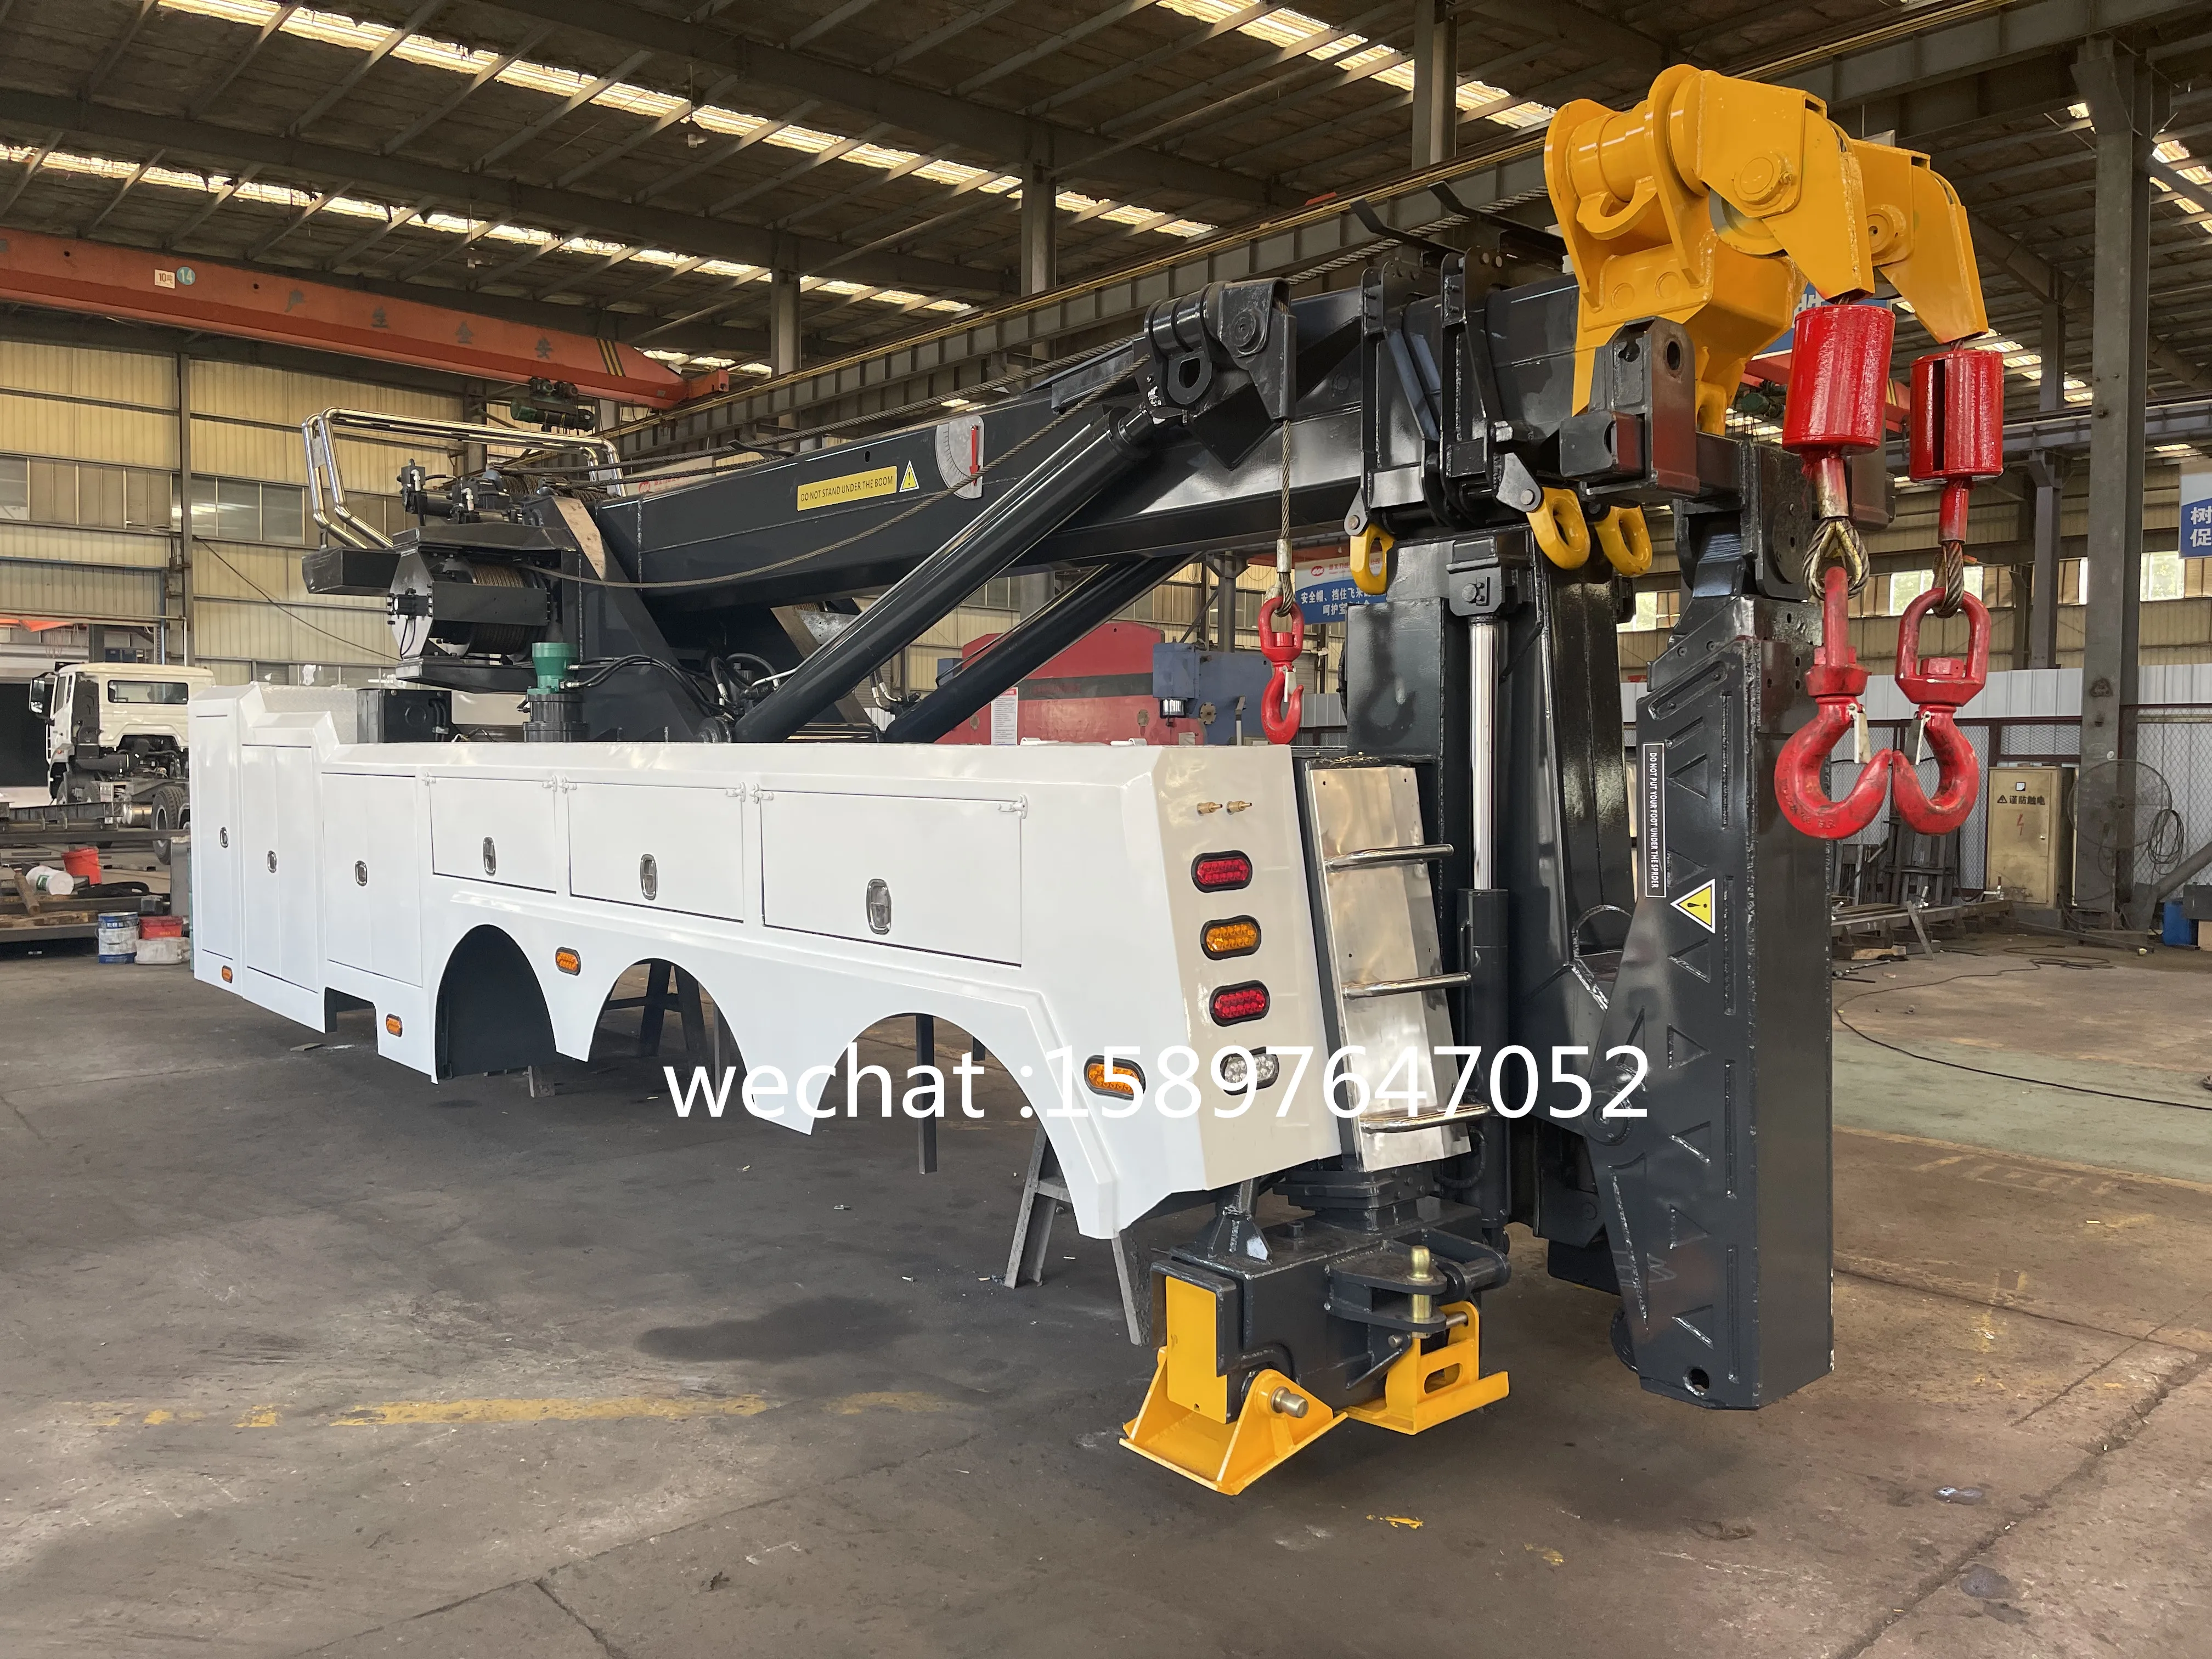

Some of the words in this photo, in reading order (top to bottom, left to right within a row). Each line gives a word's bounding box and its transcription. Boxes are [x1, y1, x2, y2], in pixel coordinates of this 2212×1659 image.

[179, 269, 193, 283] 14
[801, 492, 809, 501] DO
[810, 489, 821, 499] NOT
[822, 486, 840, 498] STAND
[842, 482, 861, 494] UNDER
[862, 479, 873, 489] THE
[874, 476, 893, 487] BOOM
[2190, 528, 2212, 548] 促
[1650, 752, 1657, 762] DO
[1650, 791, 1658, 809] YOUR
